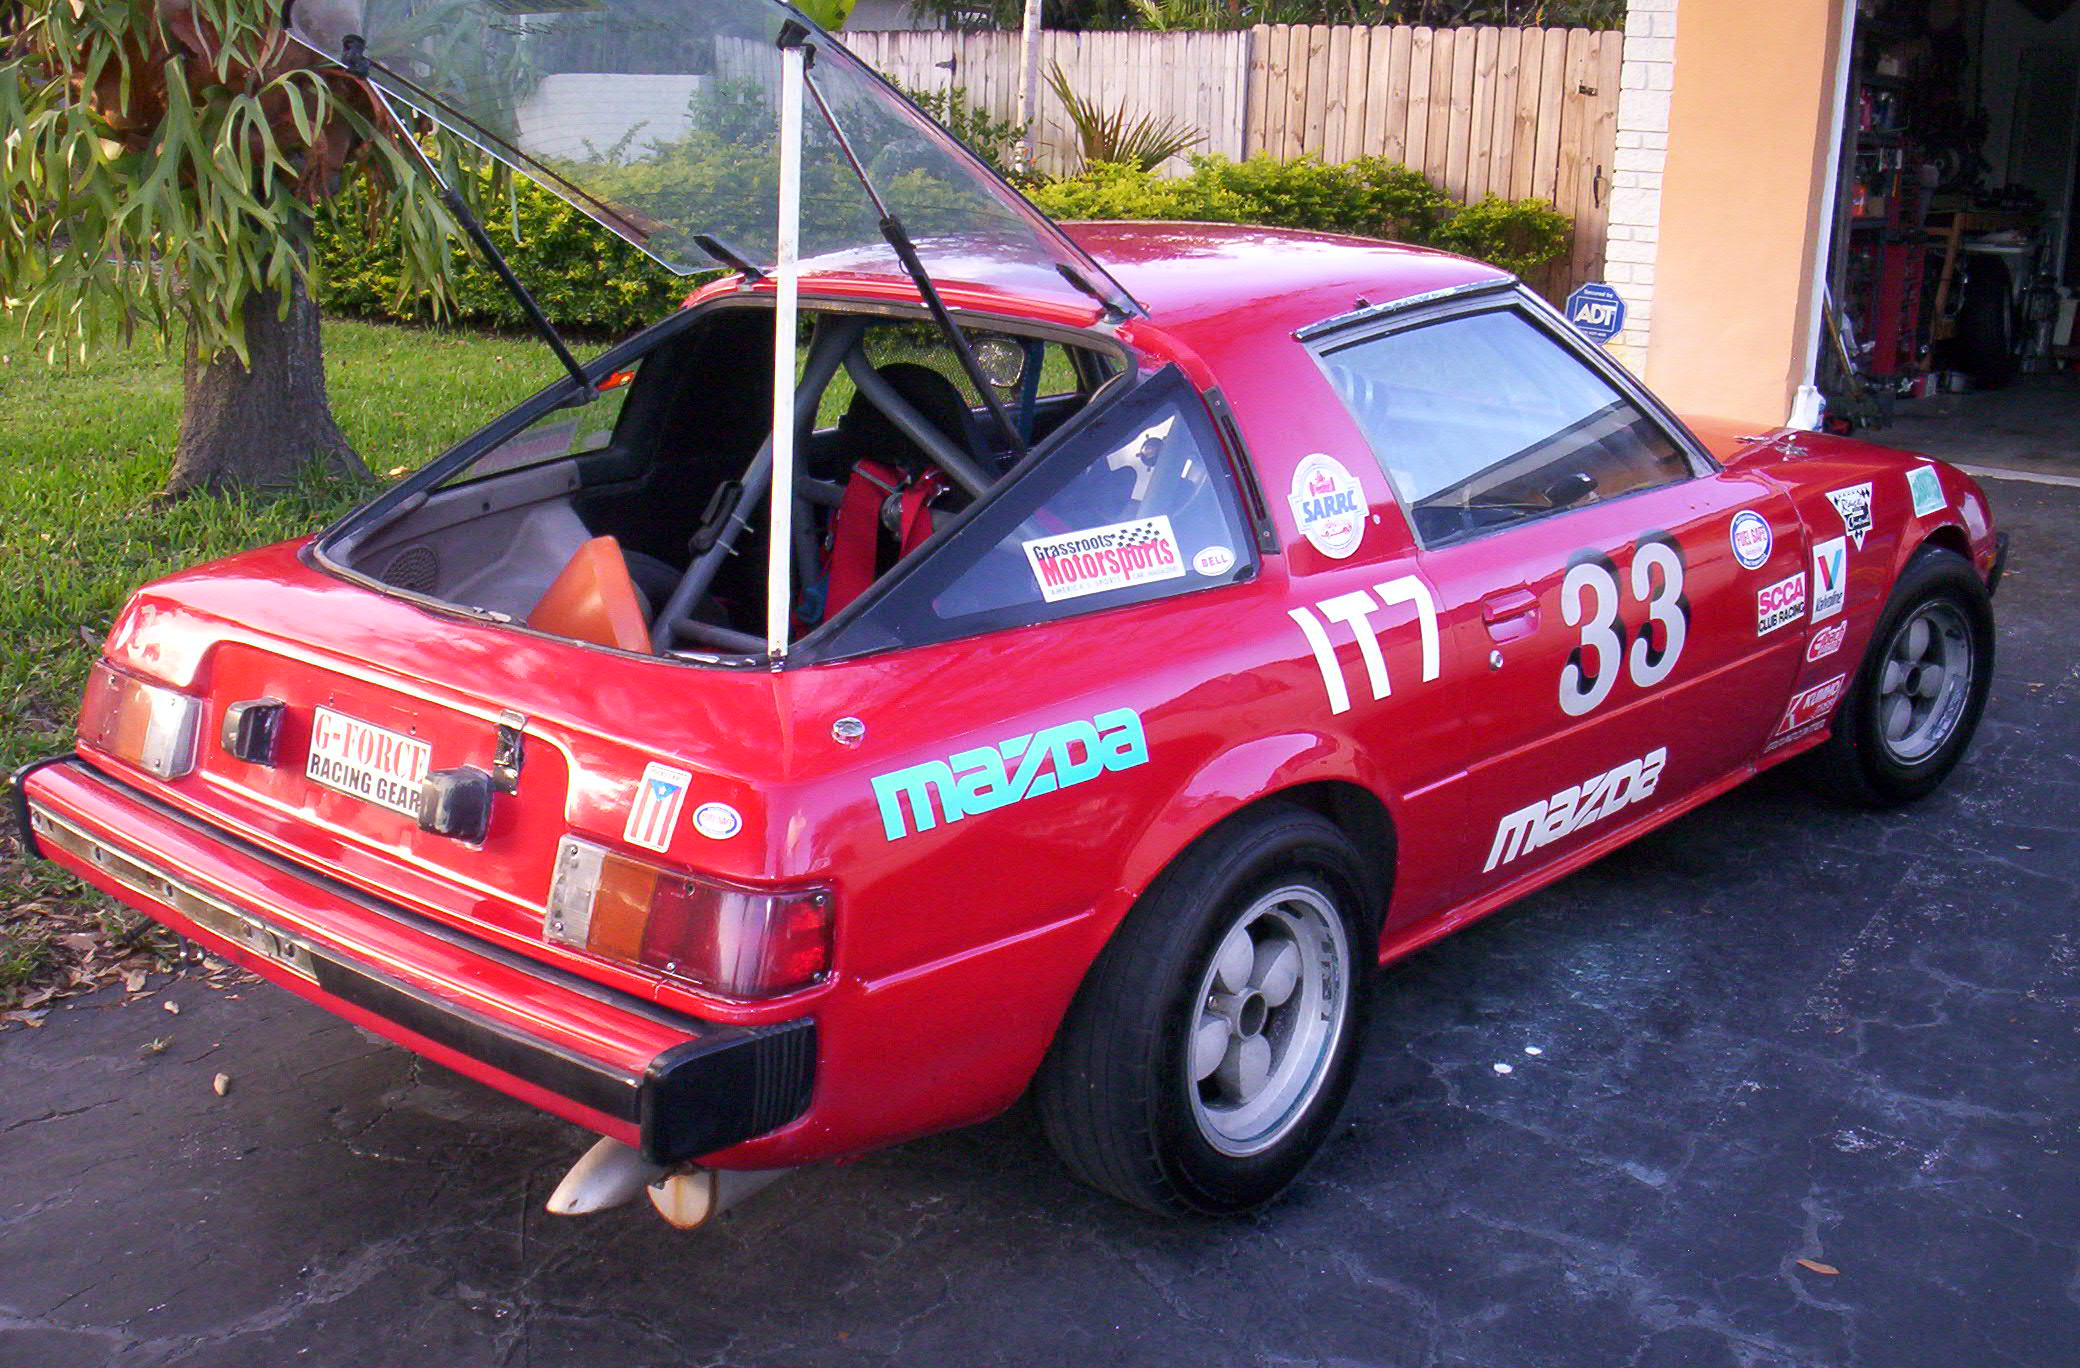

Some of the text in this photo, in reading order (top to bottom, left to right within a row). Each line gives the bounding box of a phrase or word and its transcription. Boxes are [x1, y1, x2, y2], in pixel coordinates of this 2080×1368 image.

[1573, 303, 1617, 326] ADT
[1302, 489, 1358, 524] SARRC
[1033, 534, 1113, 562] Grassroots
[1038, 538, 1175, 588] Motorsports
[1201, 554, 1229, 568] BELL
[1759, 577, 1804, 616] SCCA
[1559, 541, 1686, 717] 33
[1759, 601, 1805, 633] CLUB RACING
[1288, 574, 1440, 715] IT7
[314, 712, 427, 785] G-FORCE
[310, 752, 421, 812] RACING GEAR
